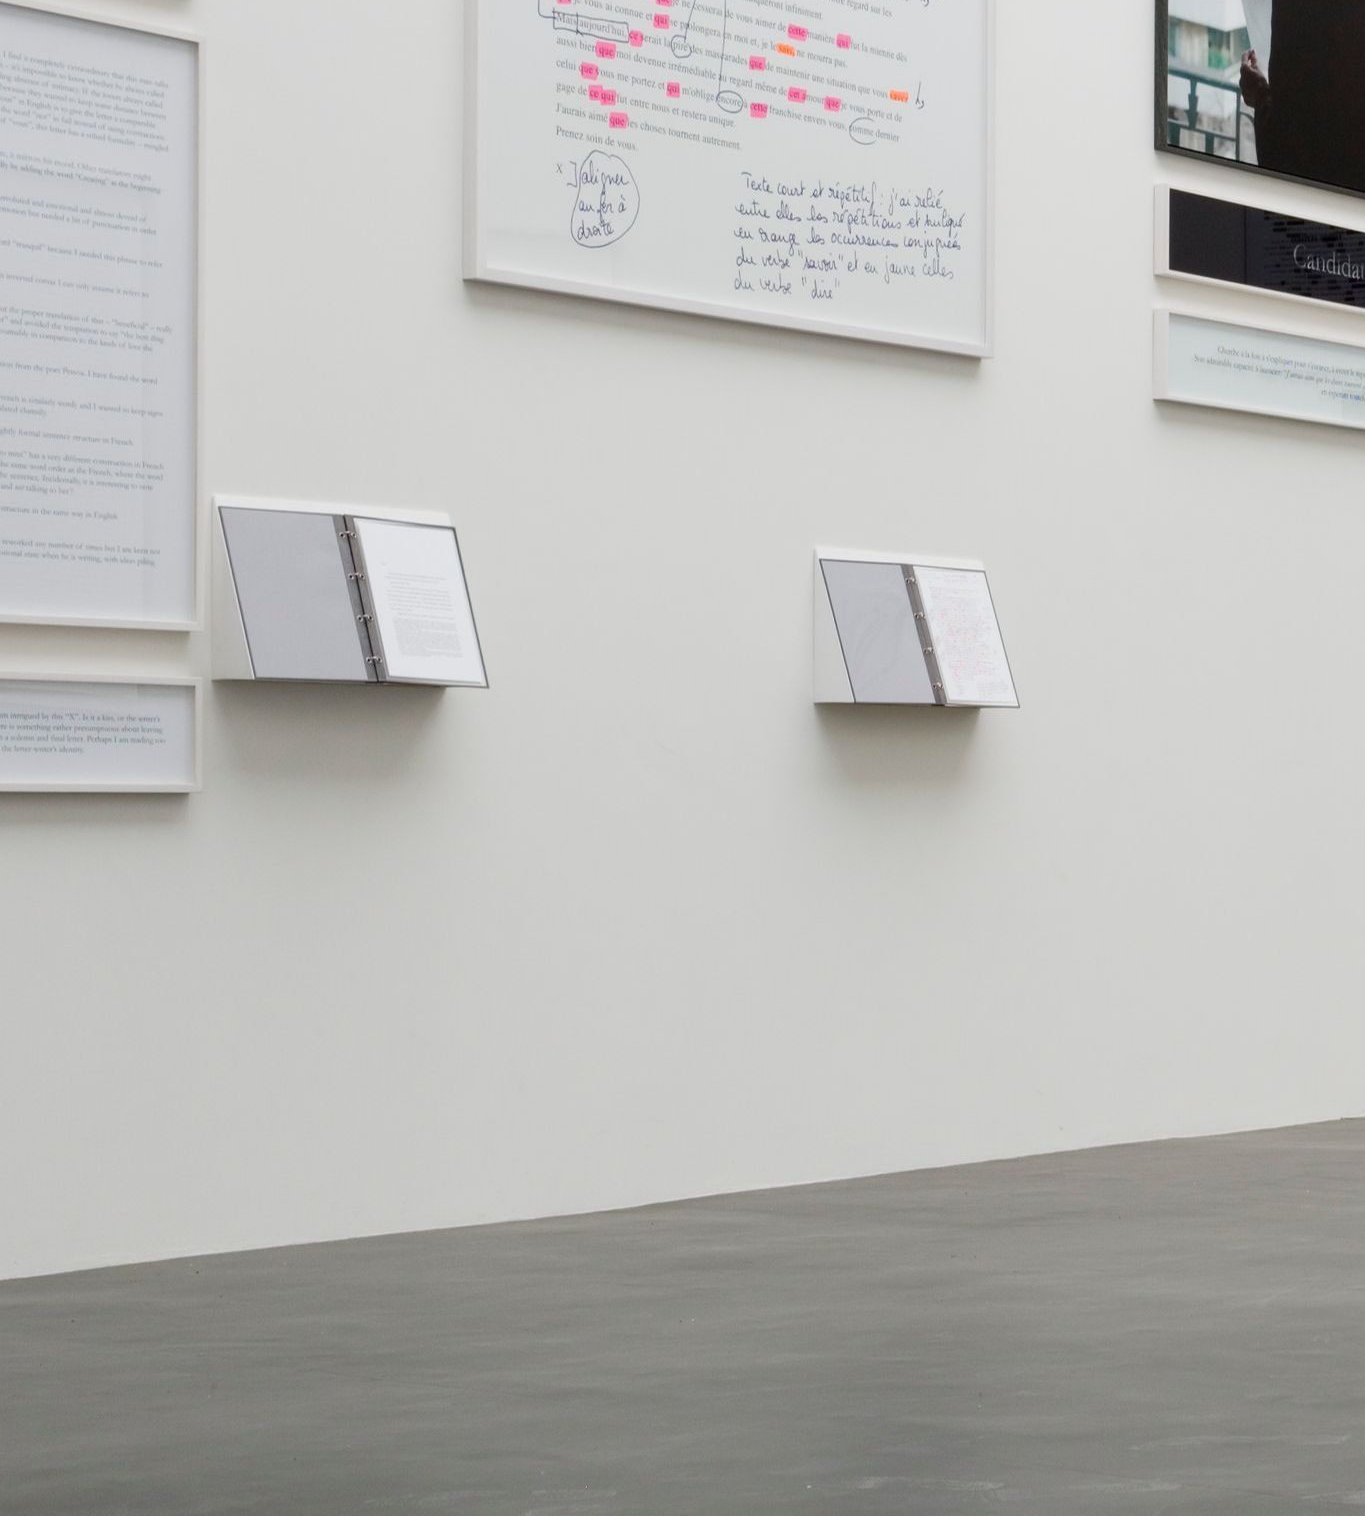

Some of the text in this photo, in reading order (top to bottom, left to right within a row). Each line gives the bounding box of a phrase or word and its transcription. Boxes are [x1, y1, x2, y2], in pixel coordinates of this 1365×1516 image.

[556, 104, 586, 118] J'aurais
[589, 110, 607, 123] aimé
[610, 115, 625, 127] que
[640, 120, 666, 136] choses
[556, 126, 583, 141] Prenez
[586, 135, 602, 144] soin
[605, 136, 614, 147] de
[618, 194, 627, 213] à
[741, 172, 772, 194] Texte
[777, 179, 806, 197] court
[810, 182, 824, 198] et
[915, 188, 943, 209] relié
[735, 202, 770, 219] entre
[776, 201, 801, 222] elles
[807, 204, 828, 224] les
[907, 213, 920, 228] et
[577, 220, 614, 240] droite
[734, 227, 753, 240] en
[761, 228, 800, 256] orange
[807, 227, 825, 245] les
[737, 247, 756, 267] du
[762, 249, 790, 269] verbe
[848, 251, 858, 273] et
[885, 256, 915, 284] jaune
[922, 256, 953, 279] celles
[1294, 244, 1365, 279] Candidat
[734, 270, 754, 291] du
[760, 274, 792, 295] verbe
